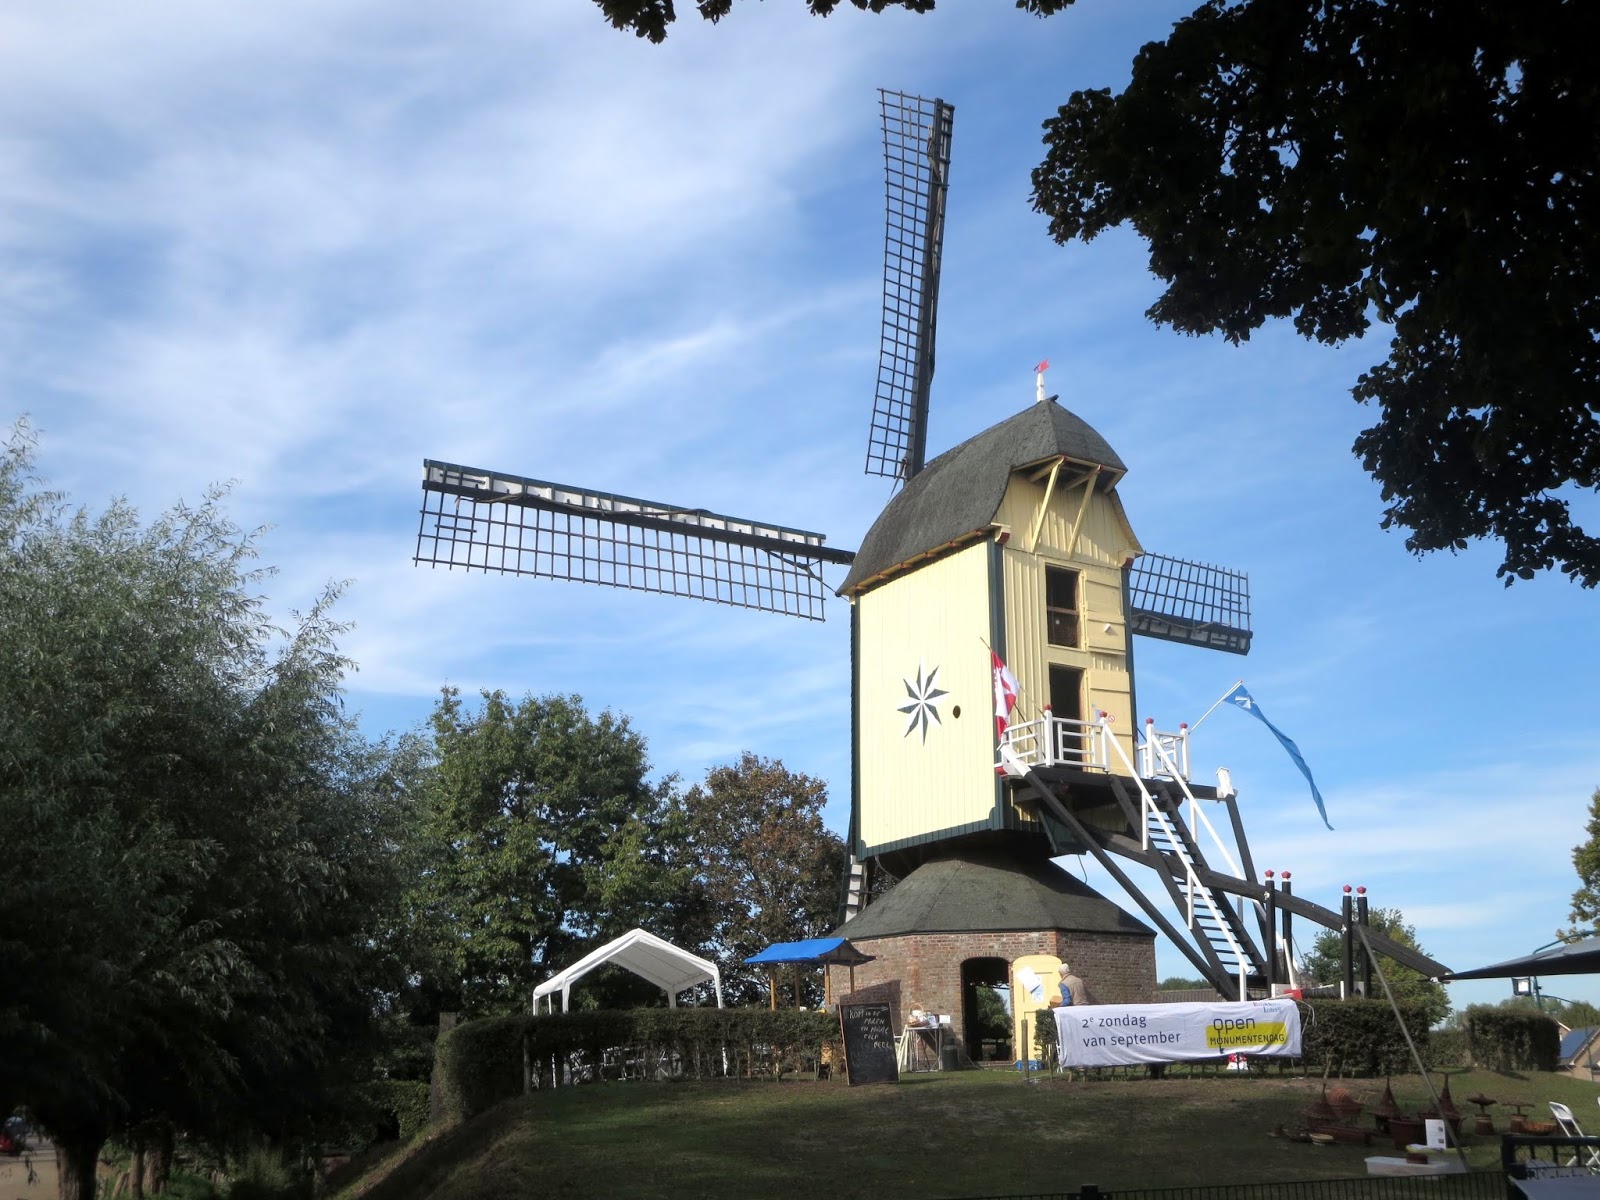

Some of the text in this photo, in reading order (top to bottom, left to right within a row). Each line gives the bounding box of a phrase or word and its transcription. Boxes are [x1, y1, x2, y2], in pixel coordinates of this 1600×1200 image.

[849, 1010, 864, 1019] KOM
[1099, 1014, 1147, 1028] zondag
[1083, 1031, 1181, 1047] van september
[1210, 1034, 1285, 1045] MONUMENTENDAG
